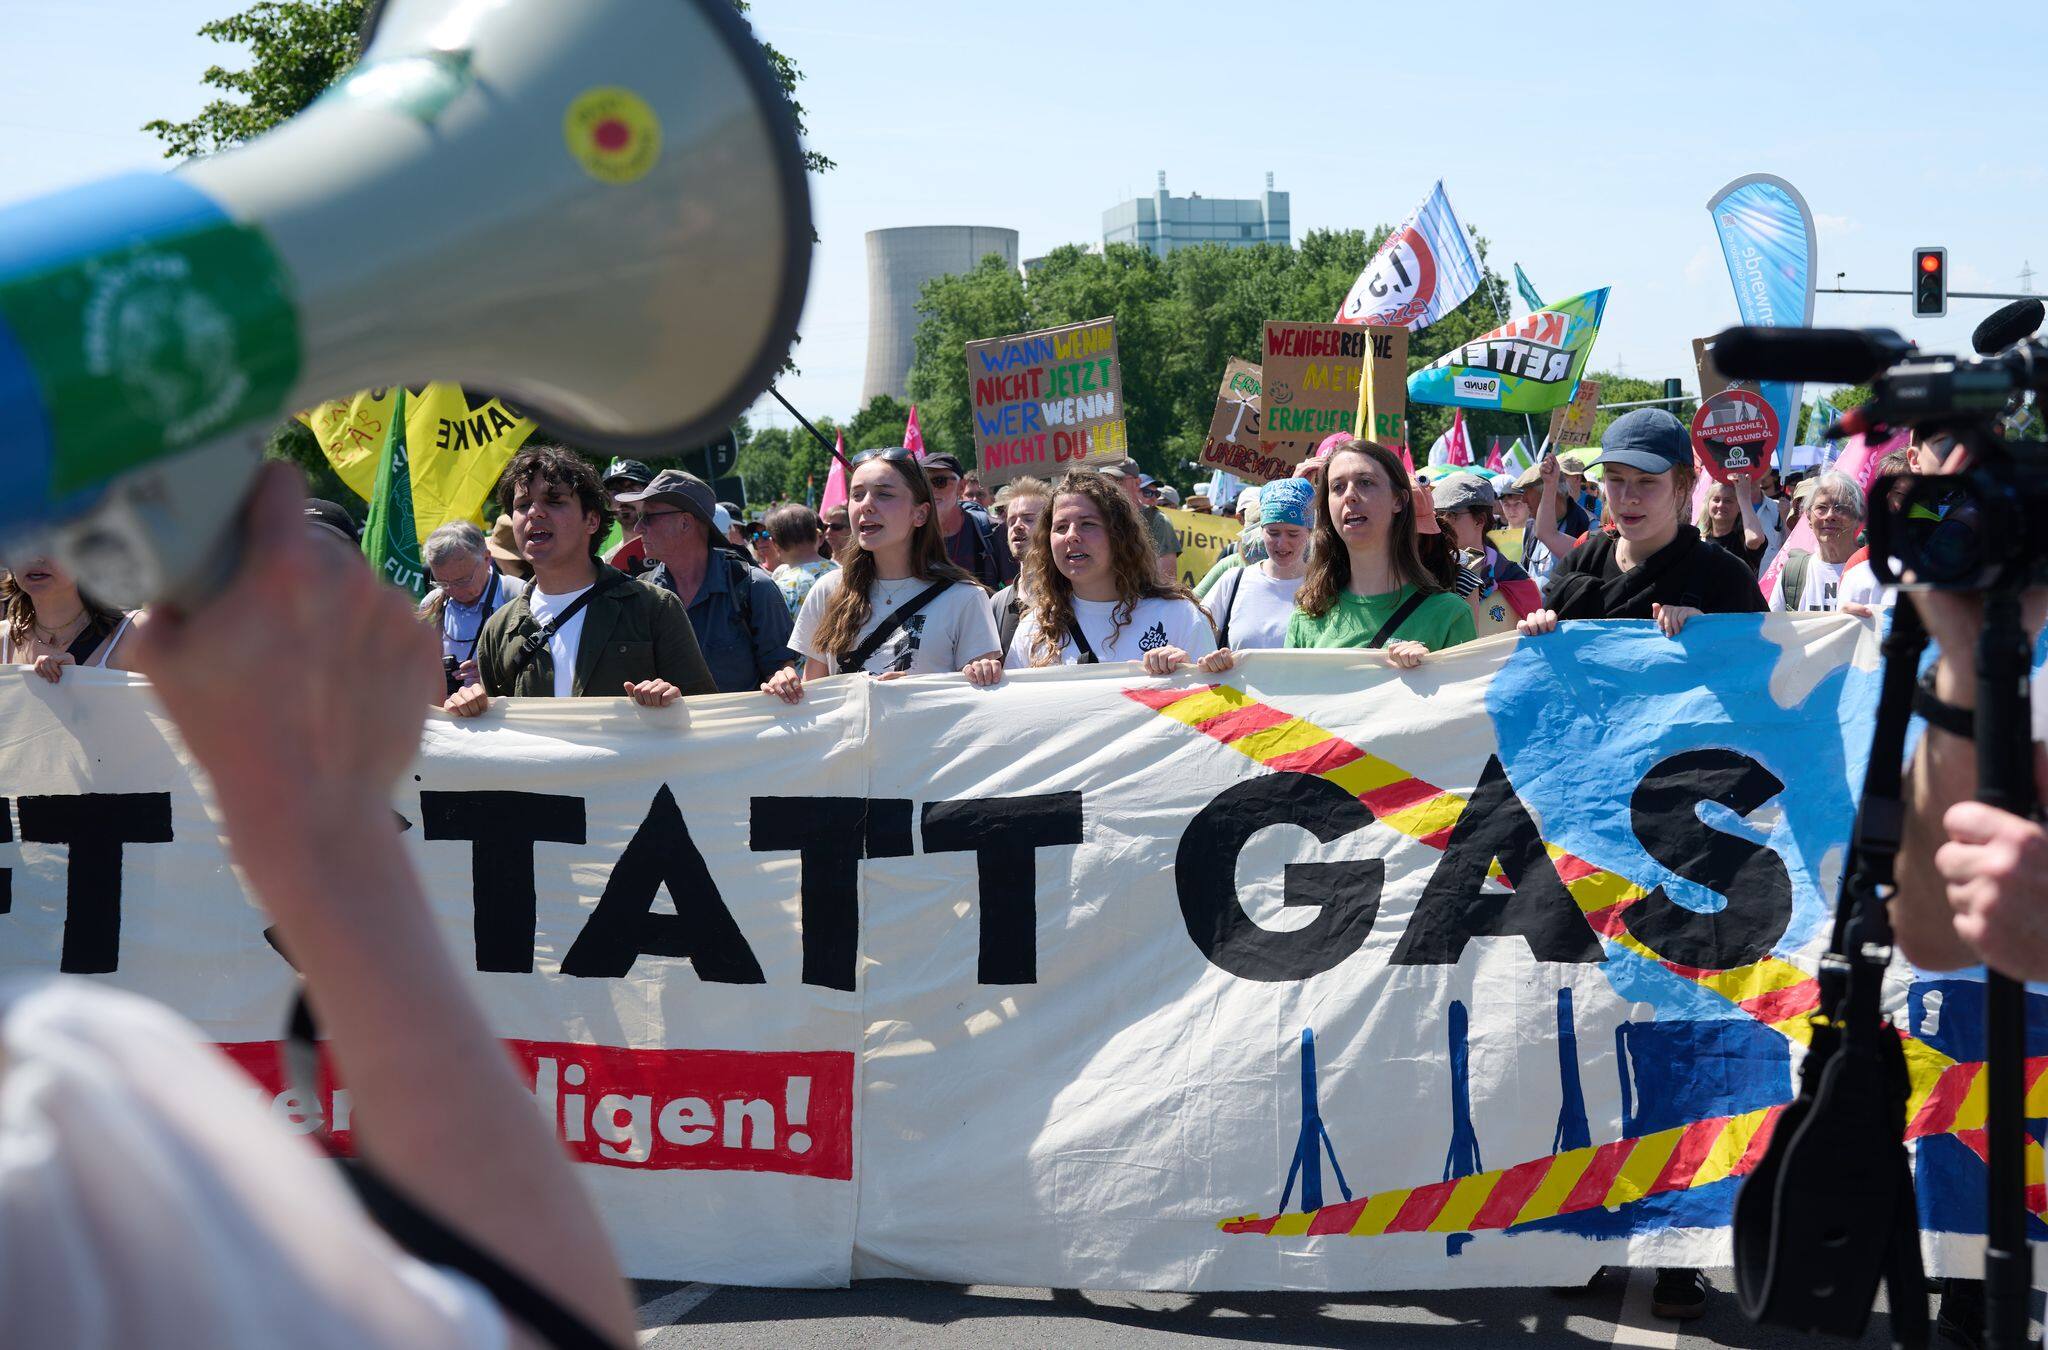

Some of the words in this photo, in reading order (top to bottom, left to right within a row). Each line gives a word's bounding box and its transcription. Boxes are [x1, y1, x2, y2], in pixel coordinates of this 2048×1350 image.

[980, 336, 1054, 372] WANN
[1053, 325, 1113, 361] WENN
[1340, 332, 1393, 359] REIHE
[976, 367, 1044, 407] NICHT
[1044, 356, 1113, 399] JETZT
[1302, 362, 1360, 392] MEH
[976, 402, 1042, 437] WER
[1041, 392, 1115, 426] WENN
[1267, 406, 1400, 439] ERNEUERRE
[1697, 429, 1718, 437] RAUS
[1719, 425, 1734, 433] AUS
[1736, 421, 1763, 431] KOHLE,
[984, 434, 1047, 472] NICHT
[1053, 429, 1088, 463] DU
[1092, 420, 1126, 456] ICH
[1762, 430, 1773, 438] ÖL
[1726, 459, 1749, 467] BUND
[384, 556, 424, 592] FUT
[263, 783, 1083, 994] TATT
[1176, 747, 1793, 982] GAS
